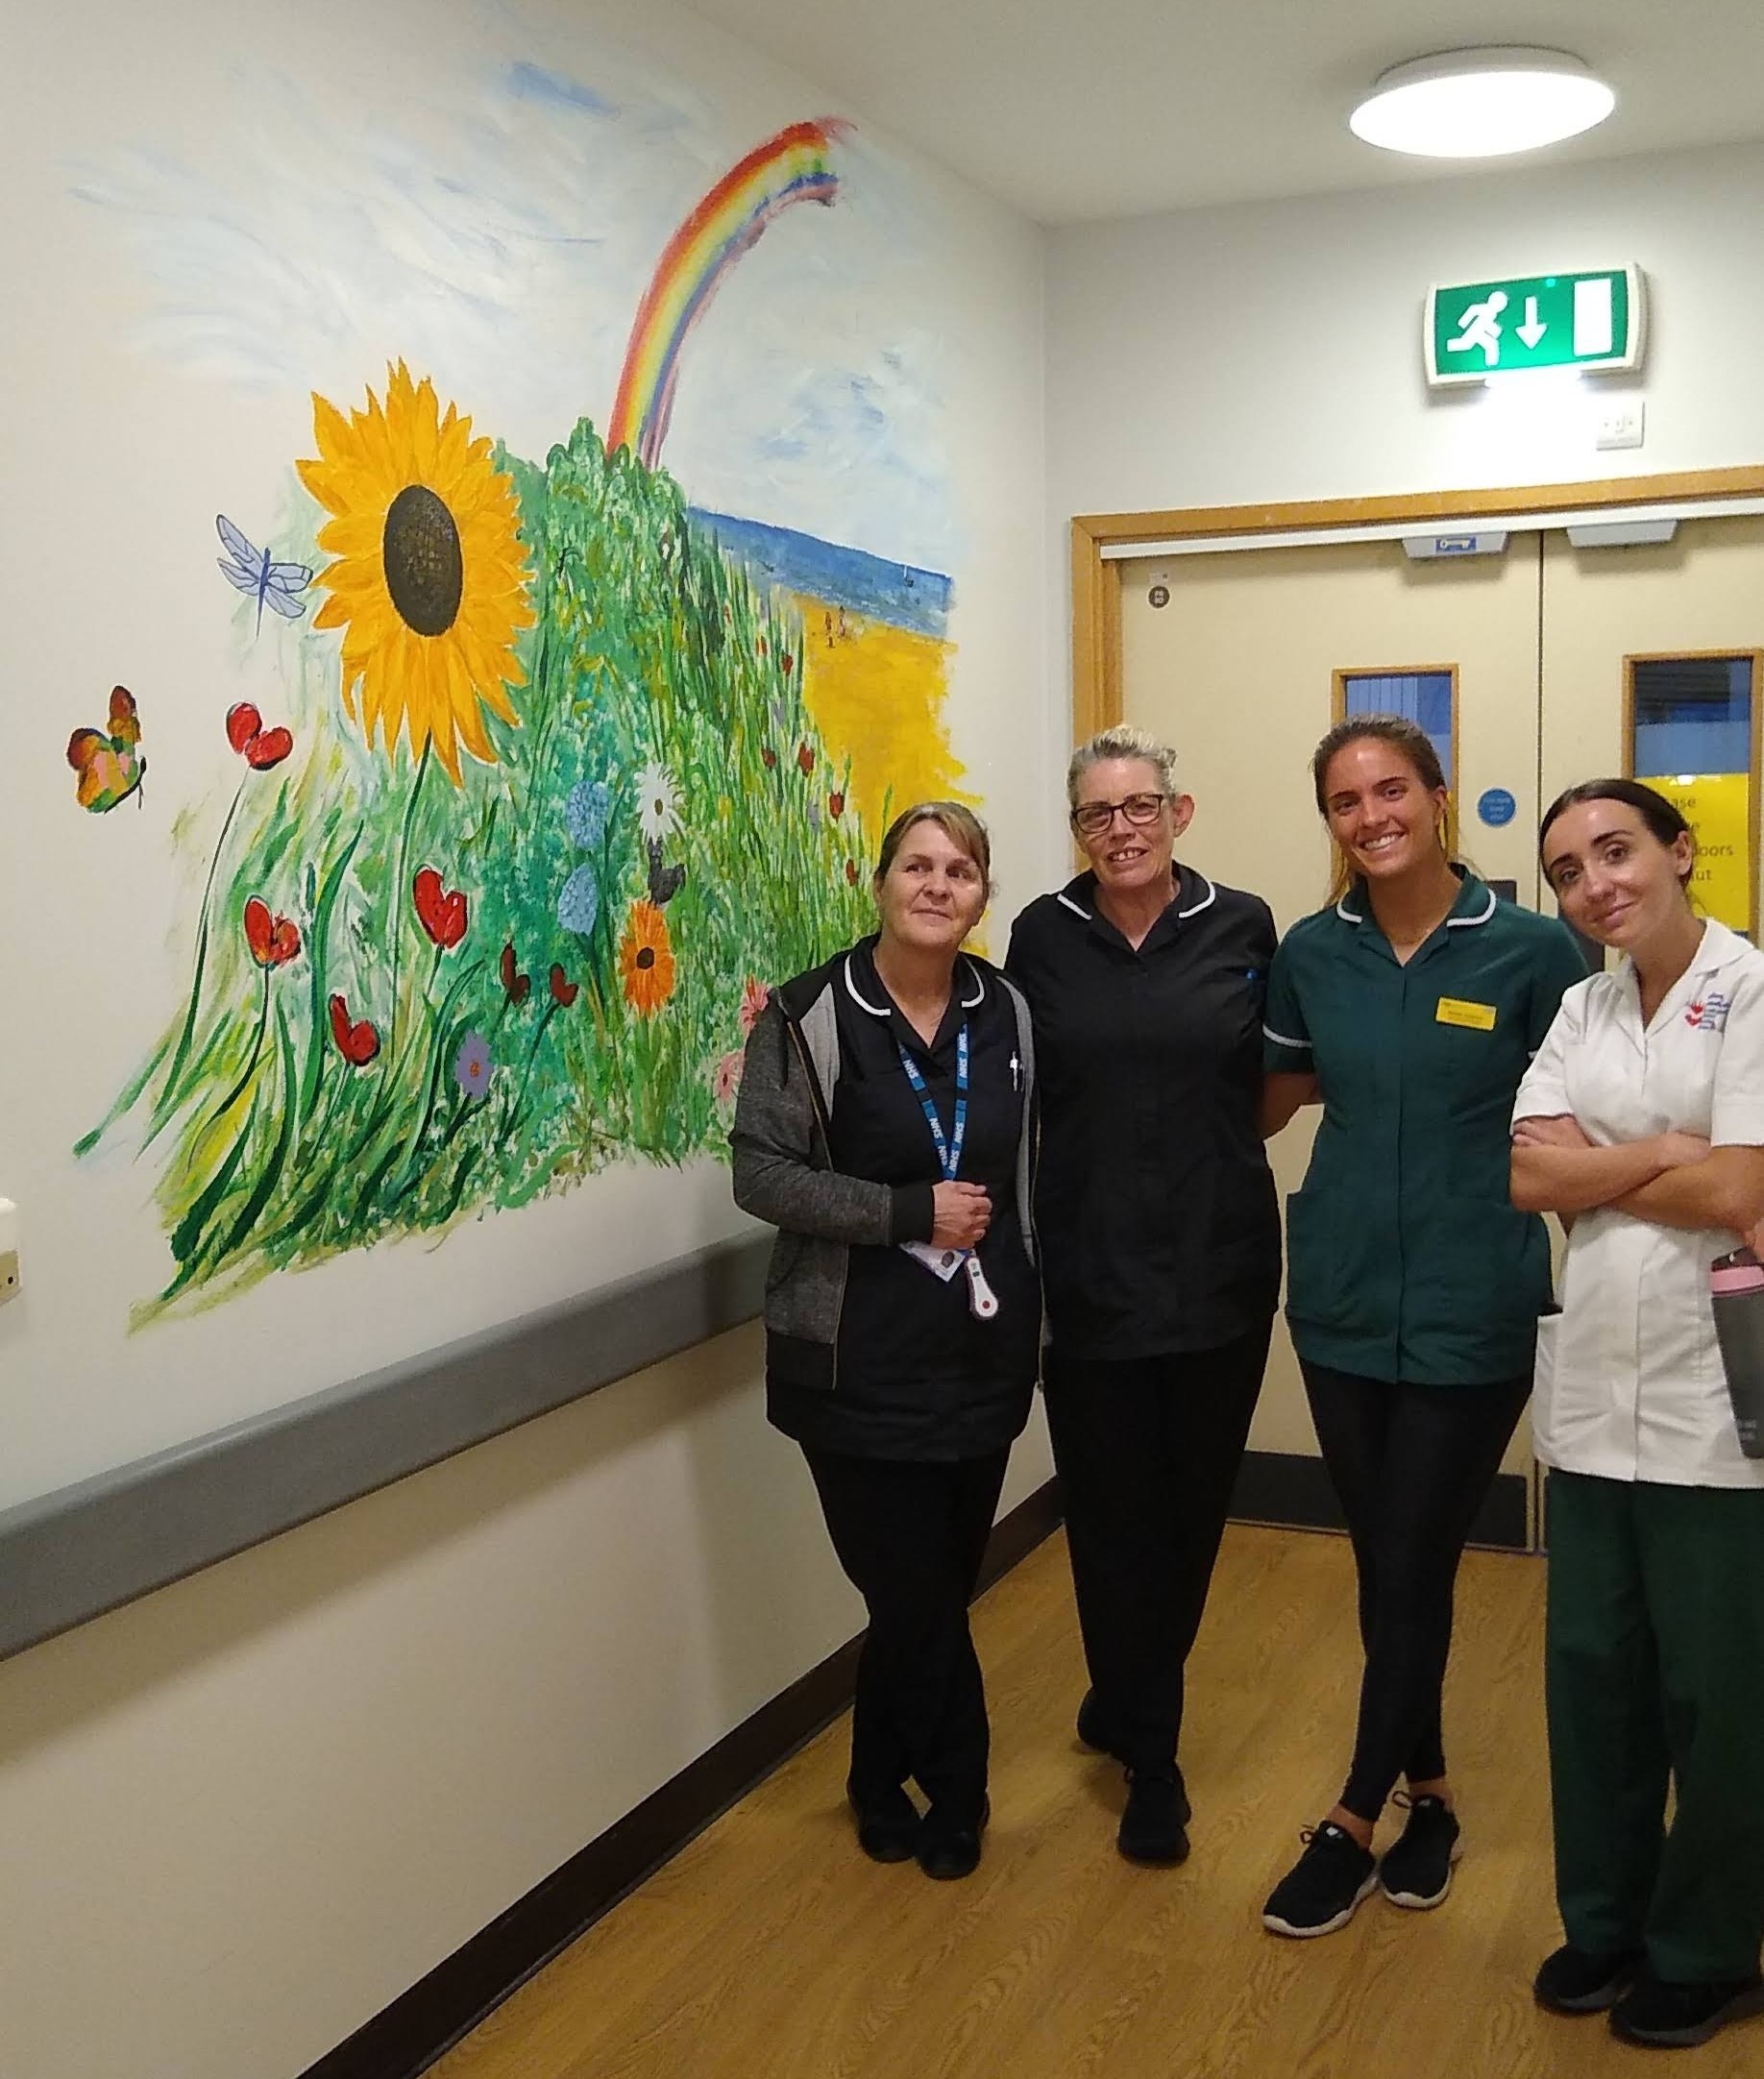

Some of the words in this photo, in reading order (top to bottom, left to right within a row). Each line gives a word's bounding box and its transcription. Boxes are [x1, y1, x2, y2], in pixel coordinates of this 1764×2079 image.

[903, 1059, 919, 1079] NHS
[959, 1058, 968, 1078] NHS
[929, 1117, 943, 1138] NHS
[954, 1122, 964, 1143] NHS
[949, 1150, 959, 1171] NHS
